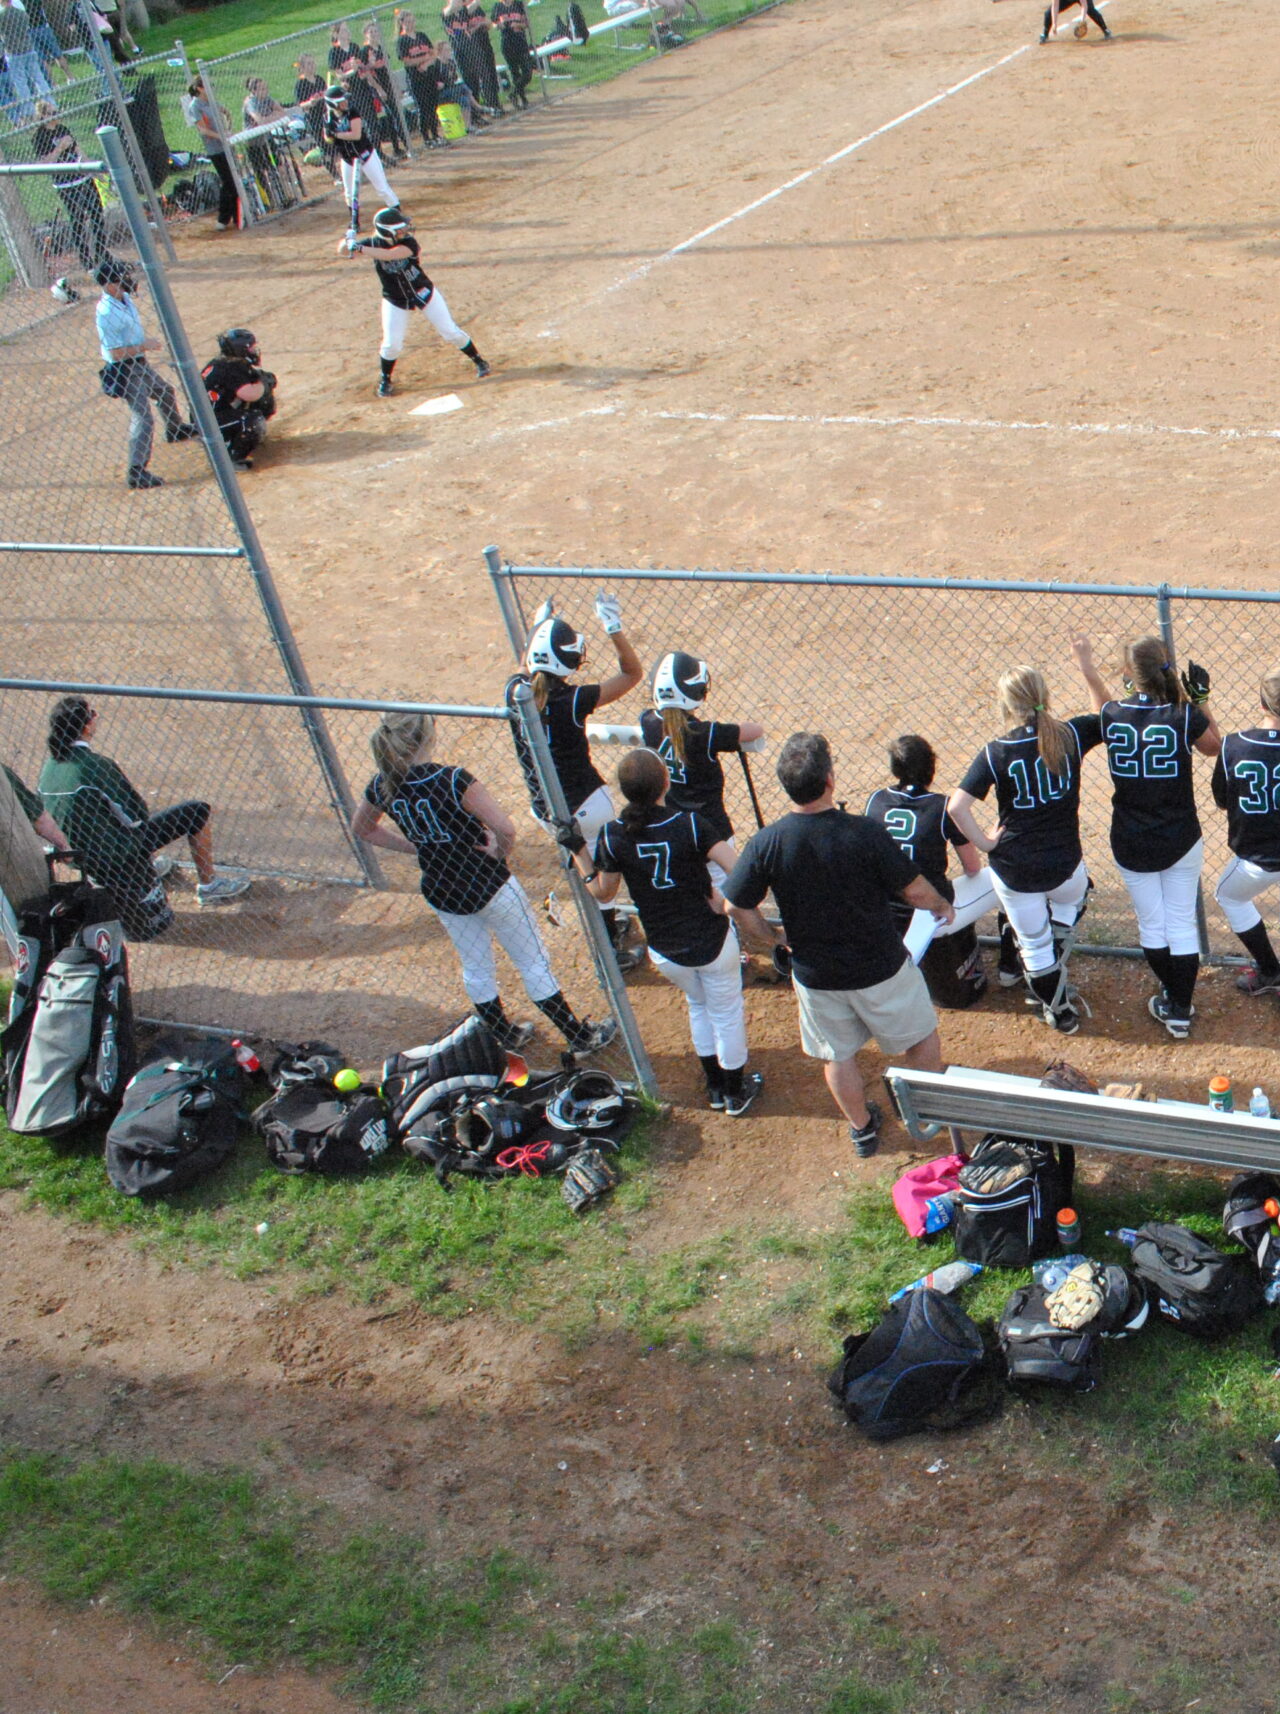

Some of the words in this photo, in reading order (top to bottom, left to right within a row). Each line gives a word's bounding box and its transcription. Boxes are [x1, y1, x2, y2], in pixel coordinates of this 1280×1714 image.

[1106, 722, 1178, 778] 22
[1008, 757, 1071, 809] 10
[391, 799, 450, 844] 11
[636, 842, 676, 889] 7
